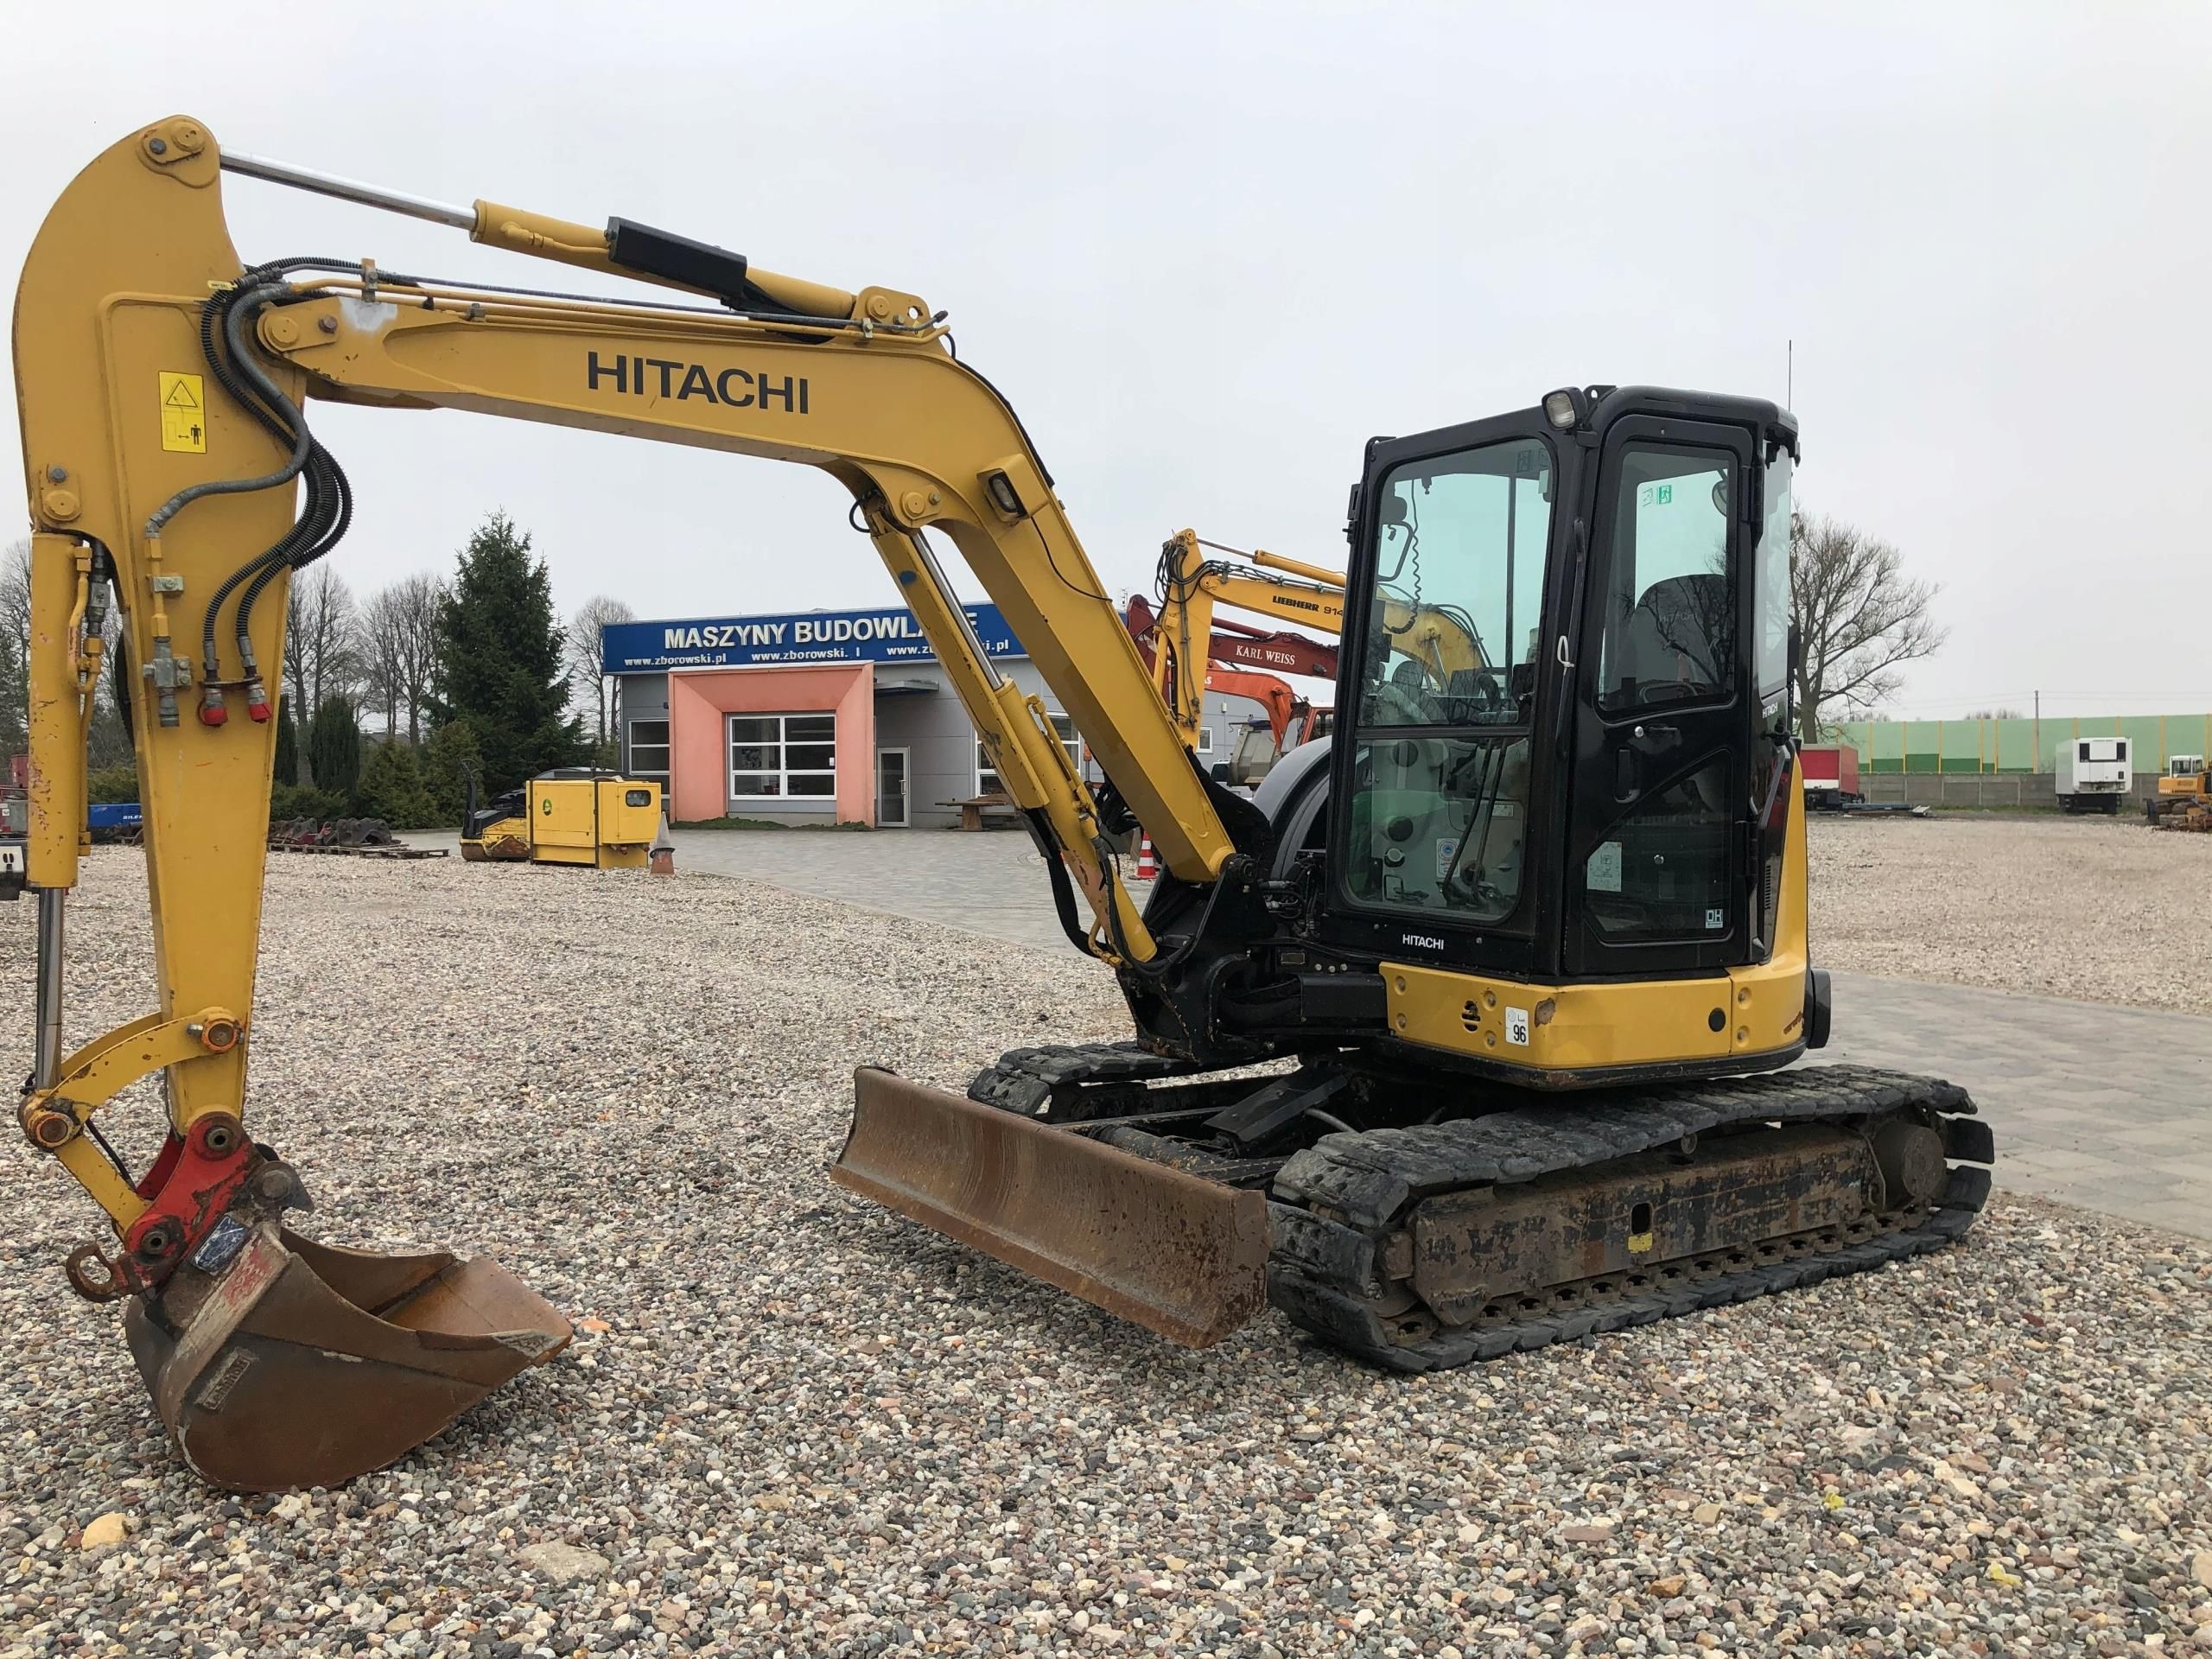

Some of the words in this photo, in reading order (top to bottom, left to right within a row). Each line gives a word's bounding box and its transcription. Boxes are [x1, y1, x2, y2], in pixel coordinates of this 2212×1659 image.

[588, 351, 809, 415] HITACHI
[1272, 595, 1319, 612] LIEBHERR
[664, 622, 788, 650] MASZYNY
[794, 612, 978, 644] BUDOWL
[624, 653, 727, 666] www.zborowski.pl
[751, 647, 861, 661] www.zborowski.l
[1236, 645, 1262, 660] KARL
[1265, 650, 1296, 665] WEISS
[1402, 934, 1444, 950] HITACHI
[1513, 1024, 1526, 1043] 96
